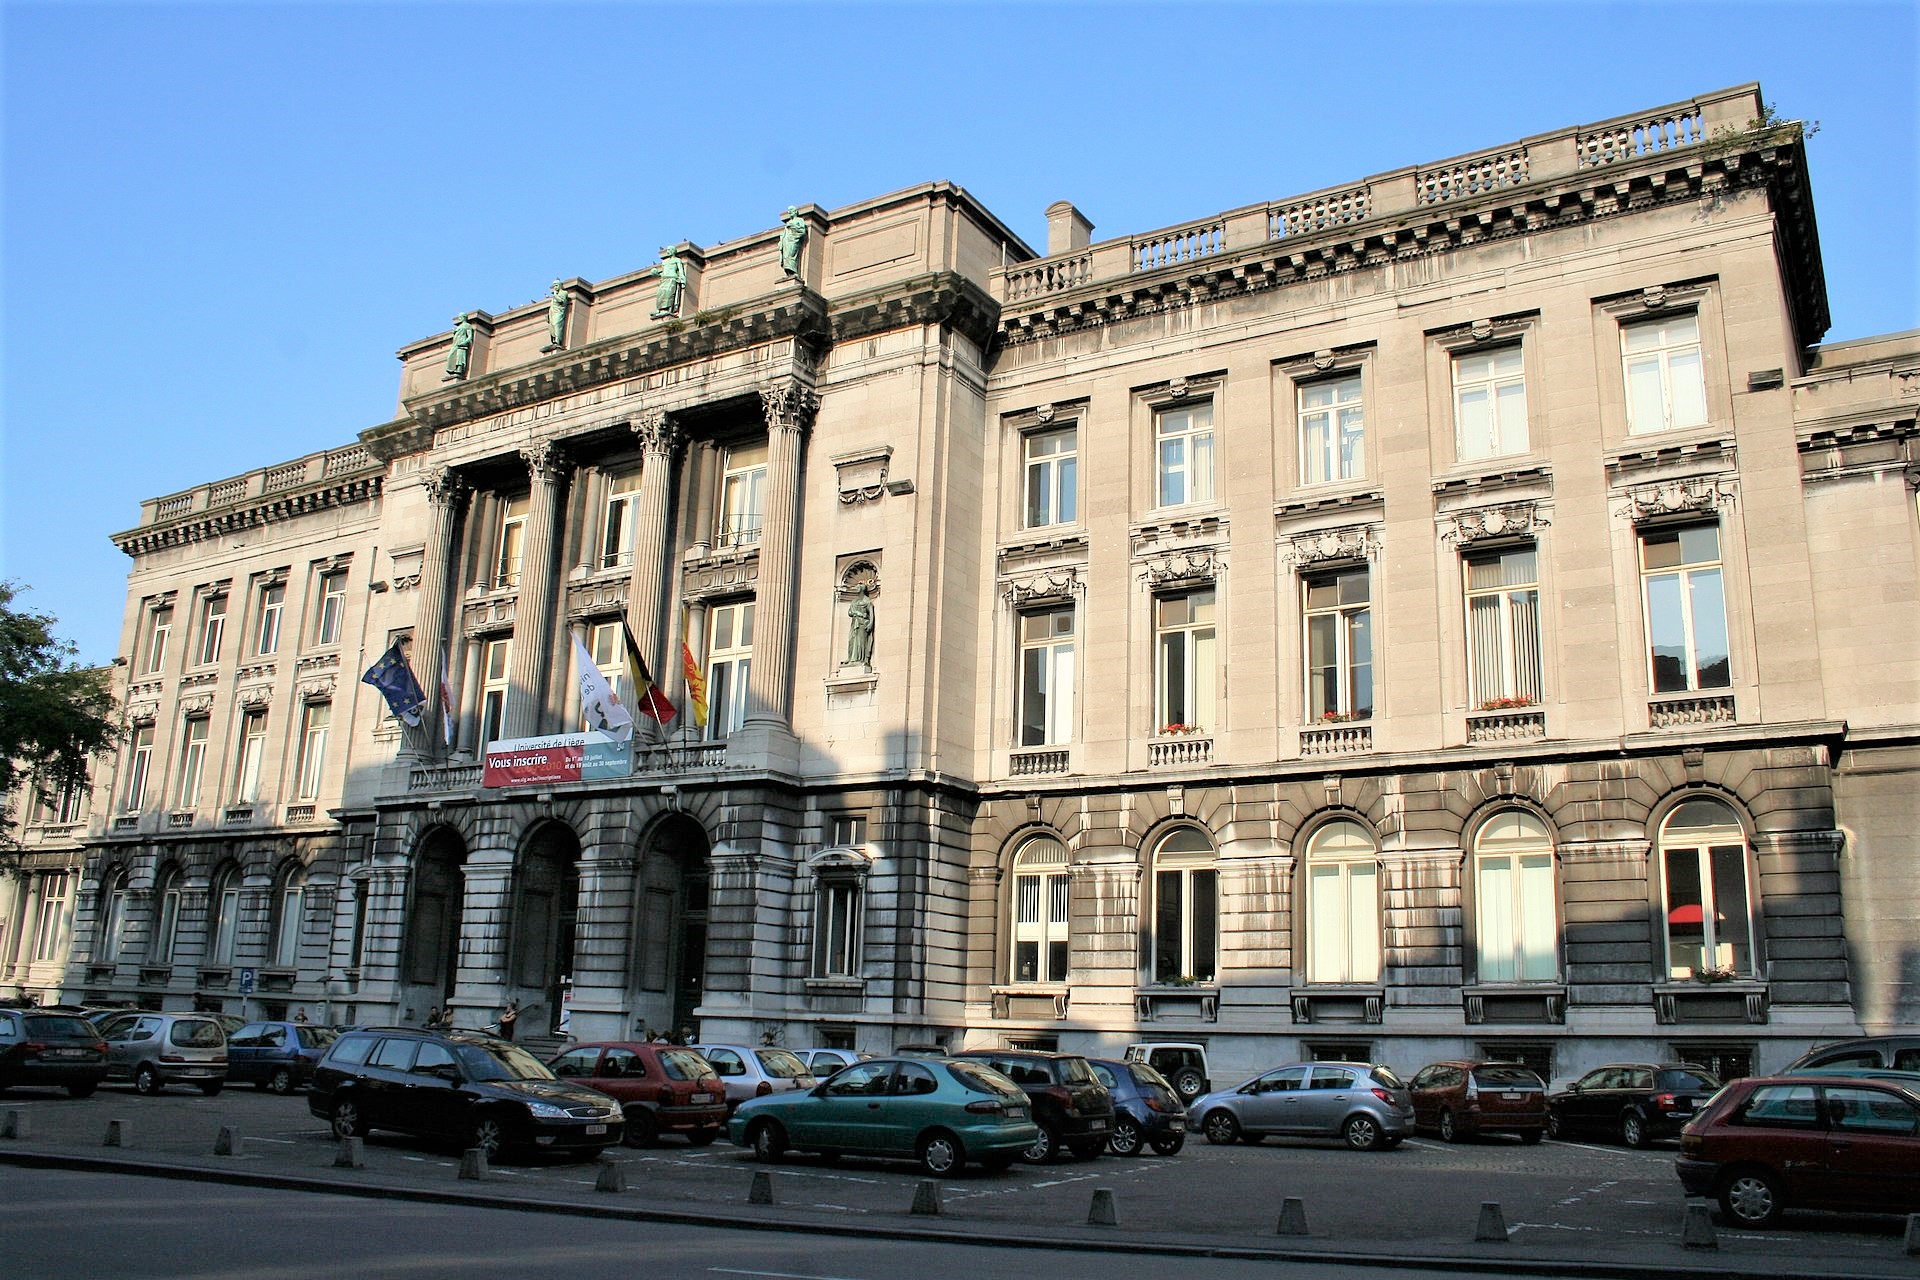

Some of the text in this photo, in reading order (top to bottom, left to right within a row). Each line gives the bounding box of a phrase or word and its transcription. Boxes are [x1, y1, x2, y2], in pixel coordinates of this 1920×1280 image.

[514, 738, 585, 751] Université de Liège
[489, 753, 548, 769] Vous inscrire
[242, 971, 252, 985] P
